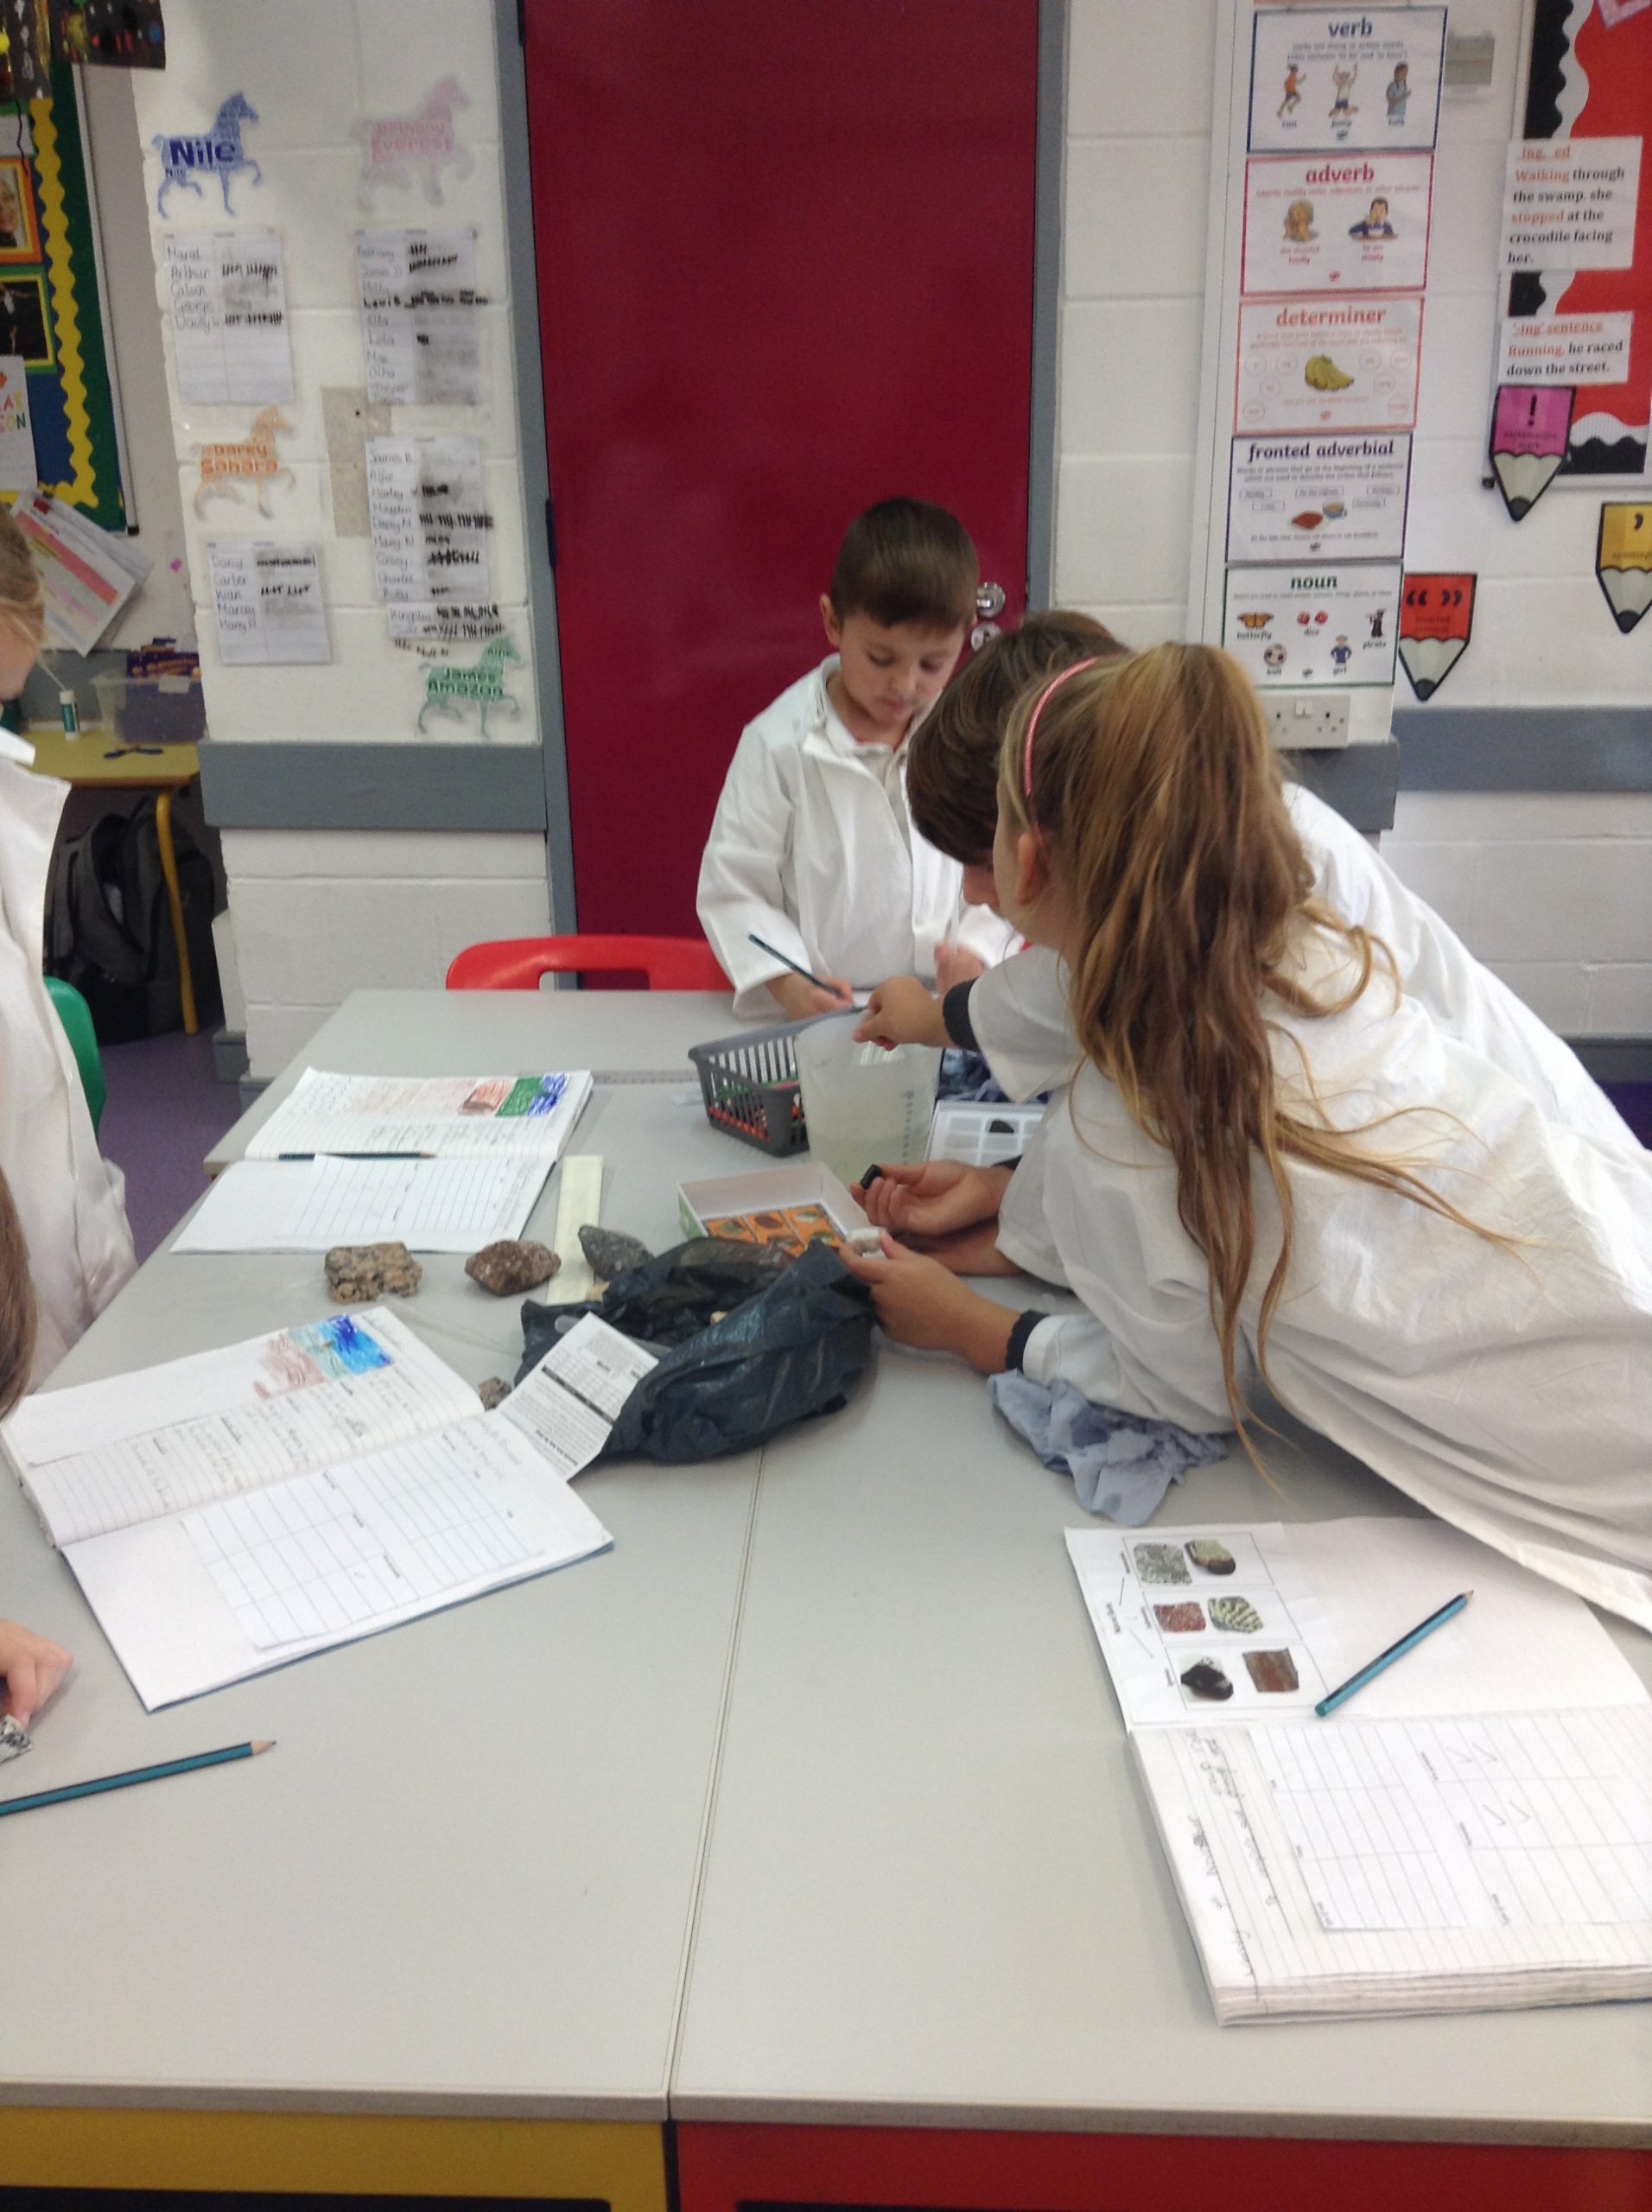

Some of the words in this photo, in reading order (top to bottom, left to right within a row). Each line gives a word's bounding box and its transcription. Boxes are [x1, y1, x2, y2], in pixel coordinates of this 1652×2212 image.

[1328, 16, 1372, 37] verb
[169, 139, 235, 168] Nile
[1306, 162, 1375, 184] adverb
[1515, 168, 1570, 183] Walking
[1573, 166, 1625, 181] through
[1513, 190, 1534, 202] the
[1590, 188, 1613, 200] she
[1511, 210, 1564, 226] stopped
[1567, 210, 1579, 222] at
[1583, 208, 1604, 221] the
[1509, 230, 1570, 243] crocodile
[1573, 228, 1614, 244] facing
[1276, 305, 1386, 327] determiner
[1547, 321, 1604, 335] sentence
[1569, 341, 1584, 353] he
[1587, 340, 1623, 353] raced
[1507, 363, 1542, 378] down
[1545, 362, 1566, 375] the
[1248, 441, 1310, 463] fronted
[1317, 439, 1395, 458] adverbial
[1291, 575, 1338, 590] noun
[1236, 629, 1272, 640] butterfly
